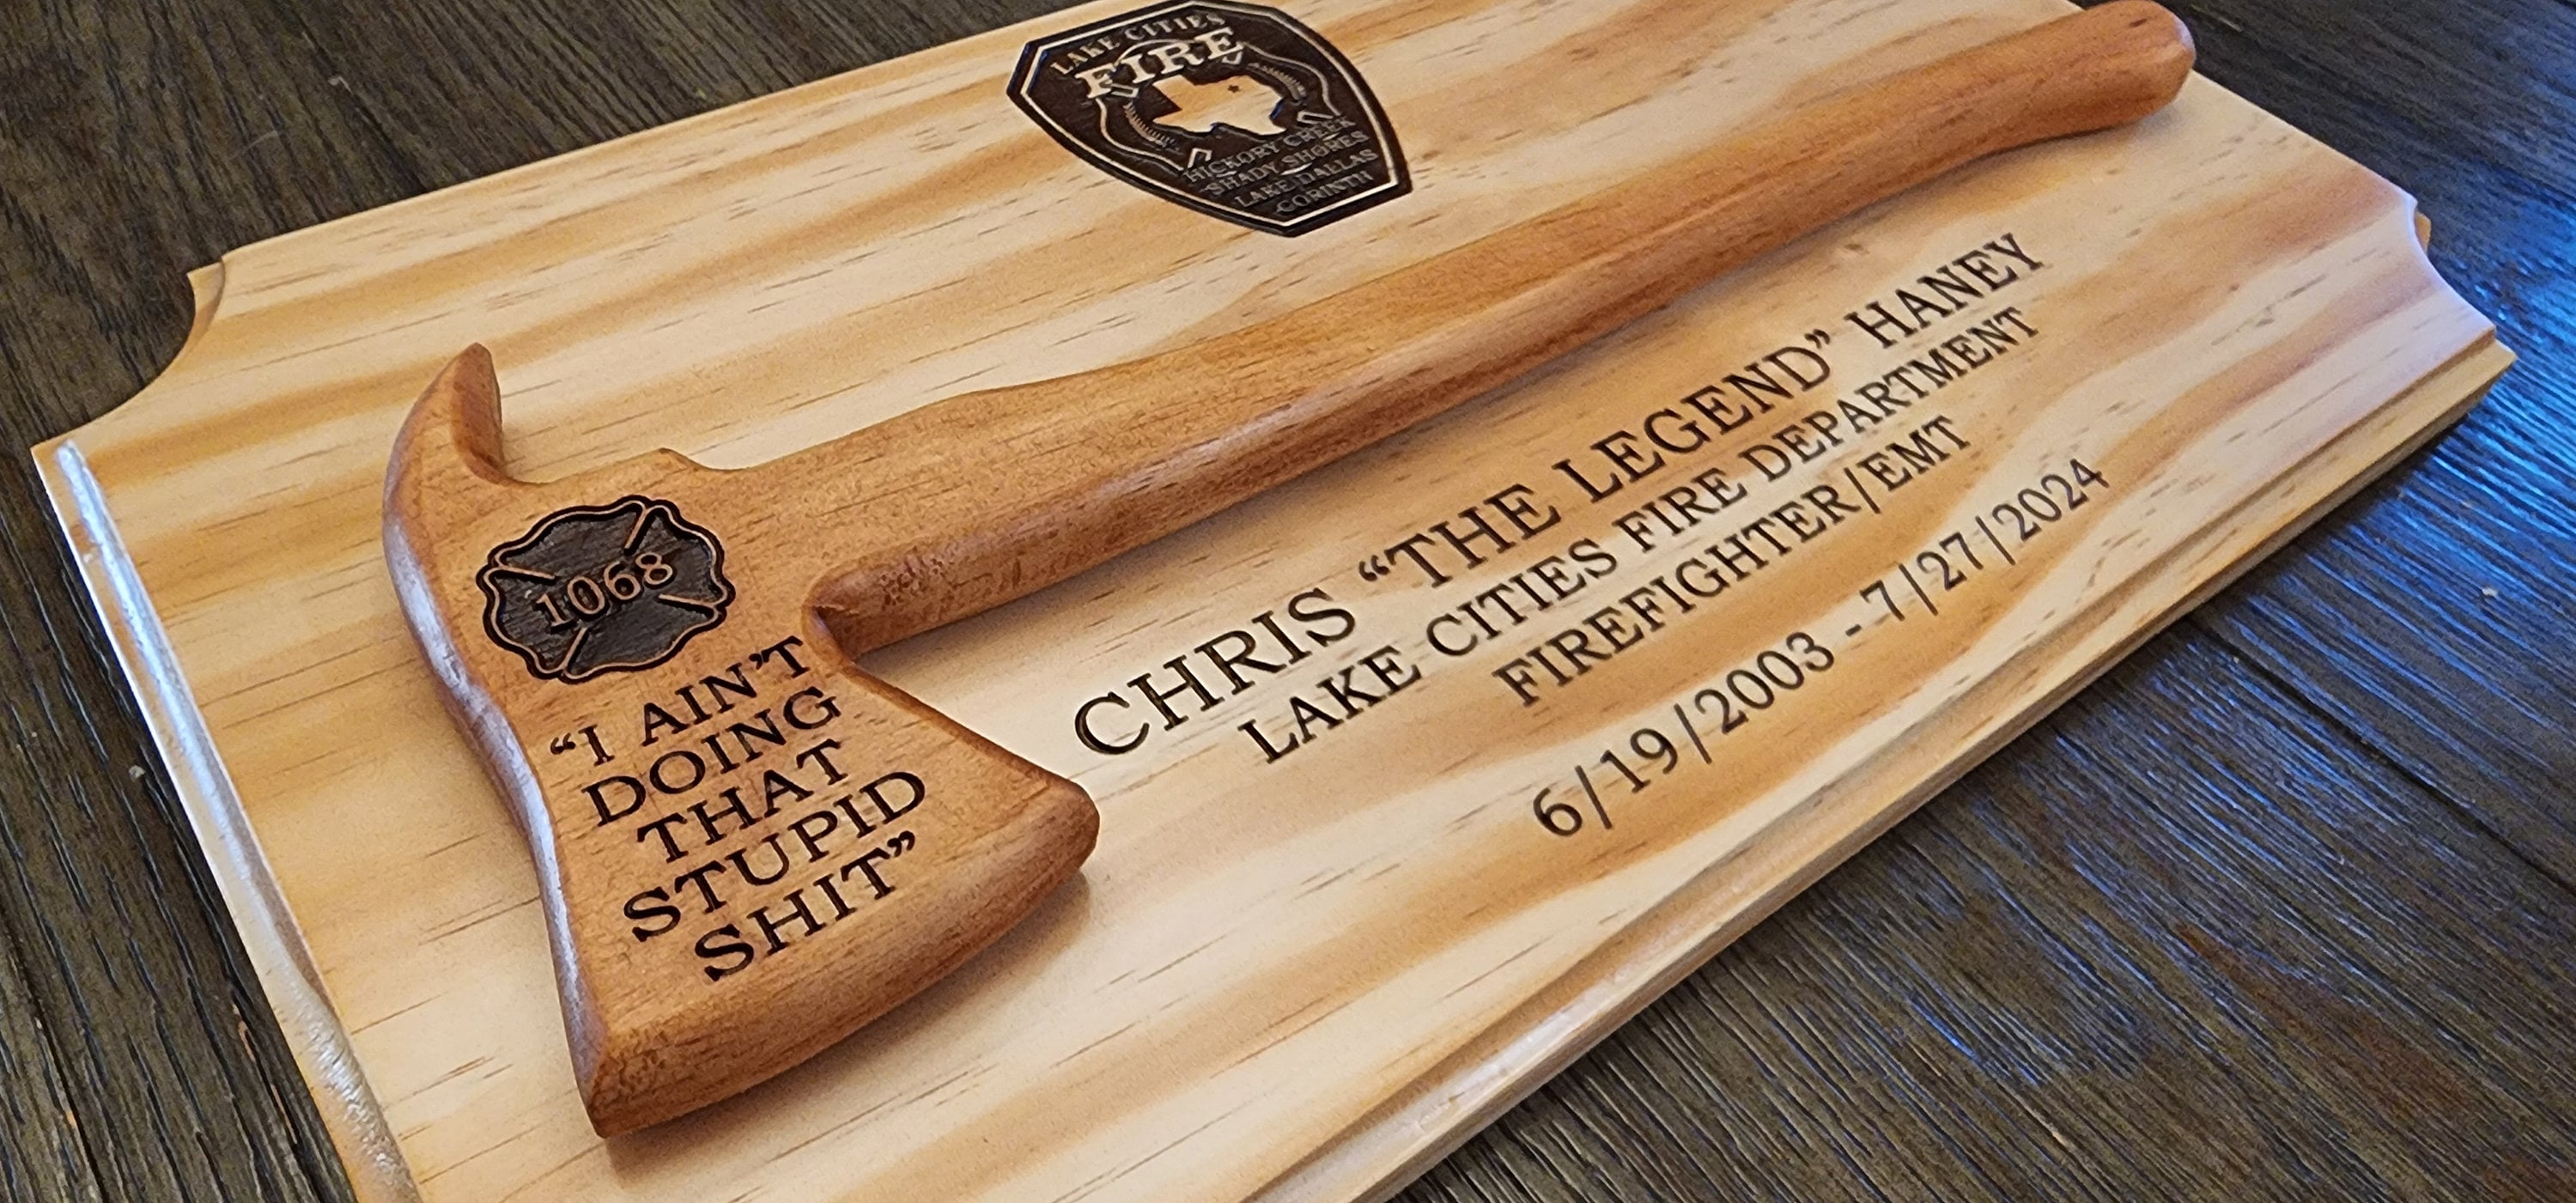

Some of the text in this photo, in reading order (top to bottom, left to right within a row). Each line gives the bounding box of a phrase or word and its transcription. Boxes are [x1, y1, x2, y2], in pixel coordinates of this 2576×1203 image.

[1051, 11, 1226, 76] LAKE CITIES
[1074, 26, 1245, 100] FIRE
[1183, 115, 1356, 183] HICKORY CREEK
[1206, 130, 1370, 196] SHADY SHORES
[1233, 149, 1378, 208] LAKE DALLAS
[1278, 170, 1374, 213] CORINTH
[1074, 232, 2046, 755] CHRIS “THE LEGEND” HANEY
[1237, 306, 2041, 764] LAKE CITIES FIRE DEPARTMENT
[532, 551, 674, 631] 1068
[1492, 414, 1971, 708] FIREFIGHTER/EMT
[550, 635, 811, 767] “I AIN’T
[1533, 458, 2111, 839] 6/19/2003 - 7/27/2024
[581, 686, 842, 828] DOING
[636, 738, 849, 864] THAT
[623, 770, 927, 943] STUPID
[694, 829, 917, 982] SHIT”
